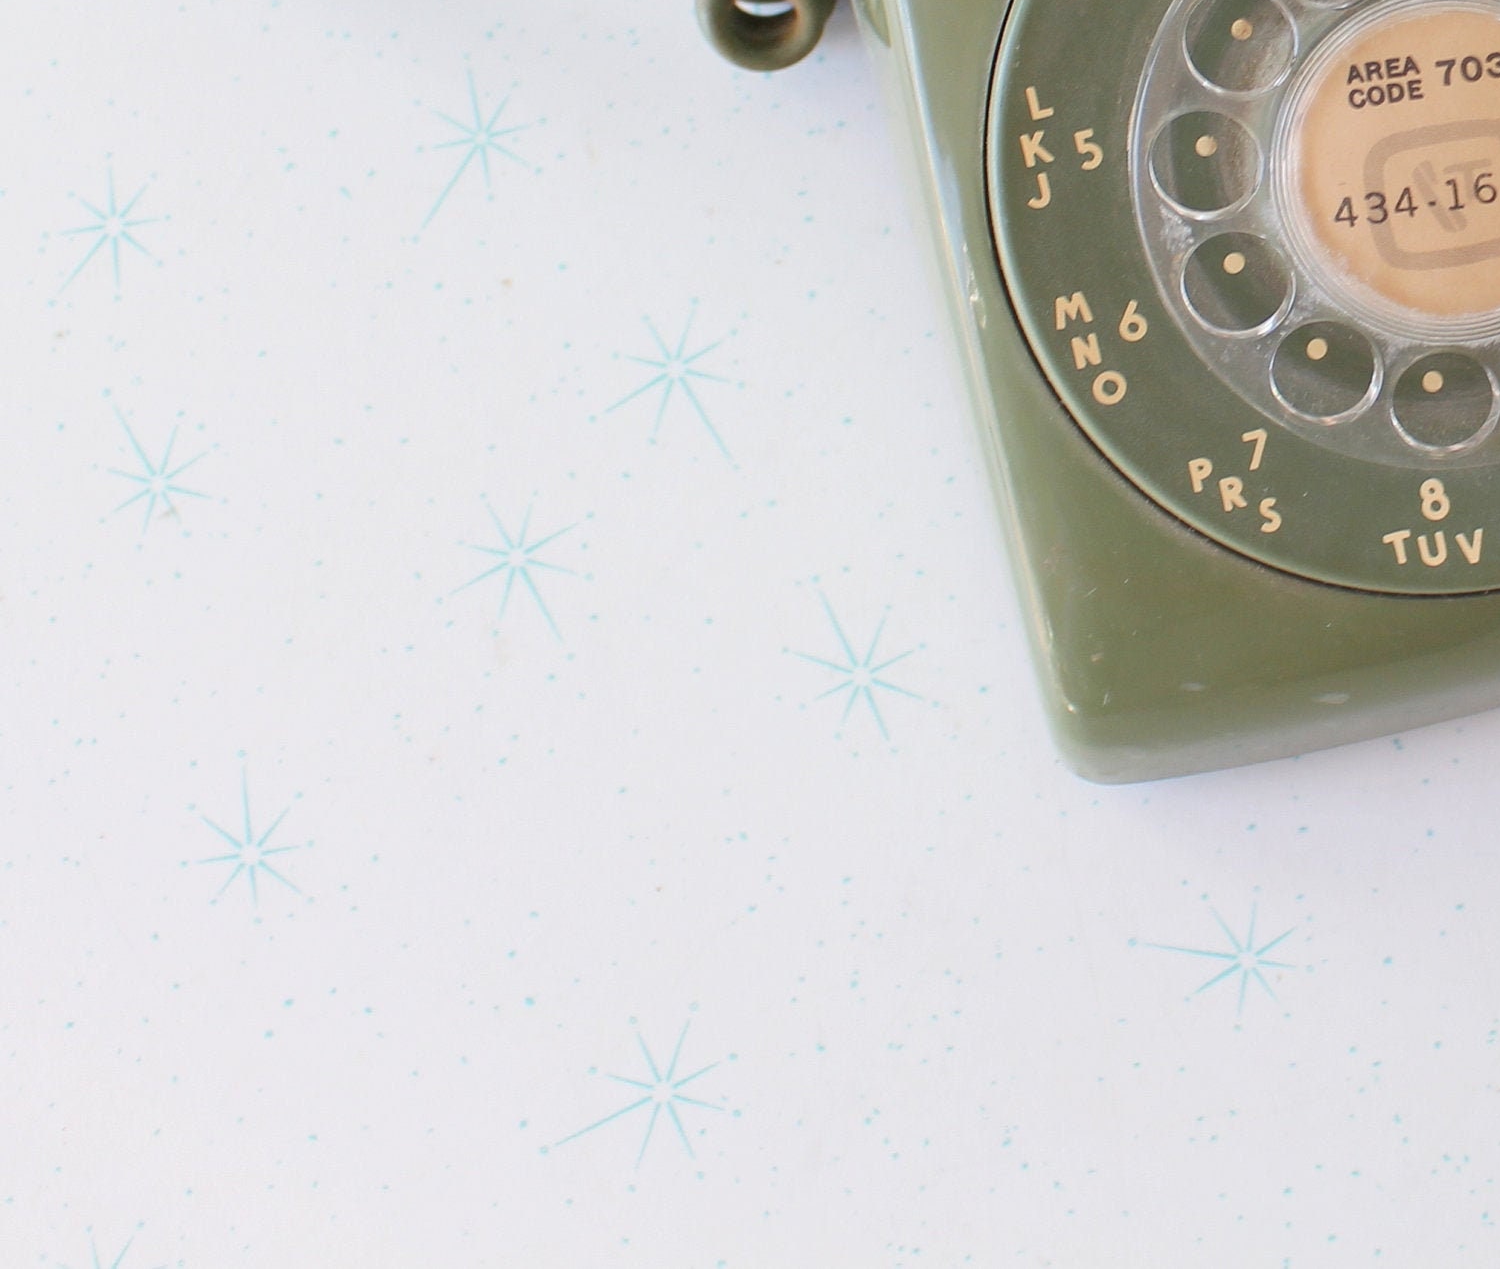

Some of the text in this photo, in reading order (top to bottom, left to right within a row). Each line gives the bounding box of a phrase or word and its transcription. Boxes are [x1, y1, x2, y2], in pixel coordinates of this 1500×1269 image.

[1347, 55, 1421, 85] AREA
[1349, 79, 1424, 109] CODE
[1074, 128, 1103, 170] 5
[1119, 299, 1148, 342] 6
[1241, 428, 1268, 471] 7
[1188, 457, 1282, 533] PRS
[1419, 477, 1451, 521] 8
[1382, 528, 1484, 566] TUV
